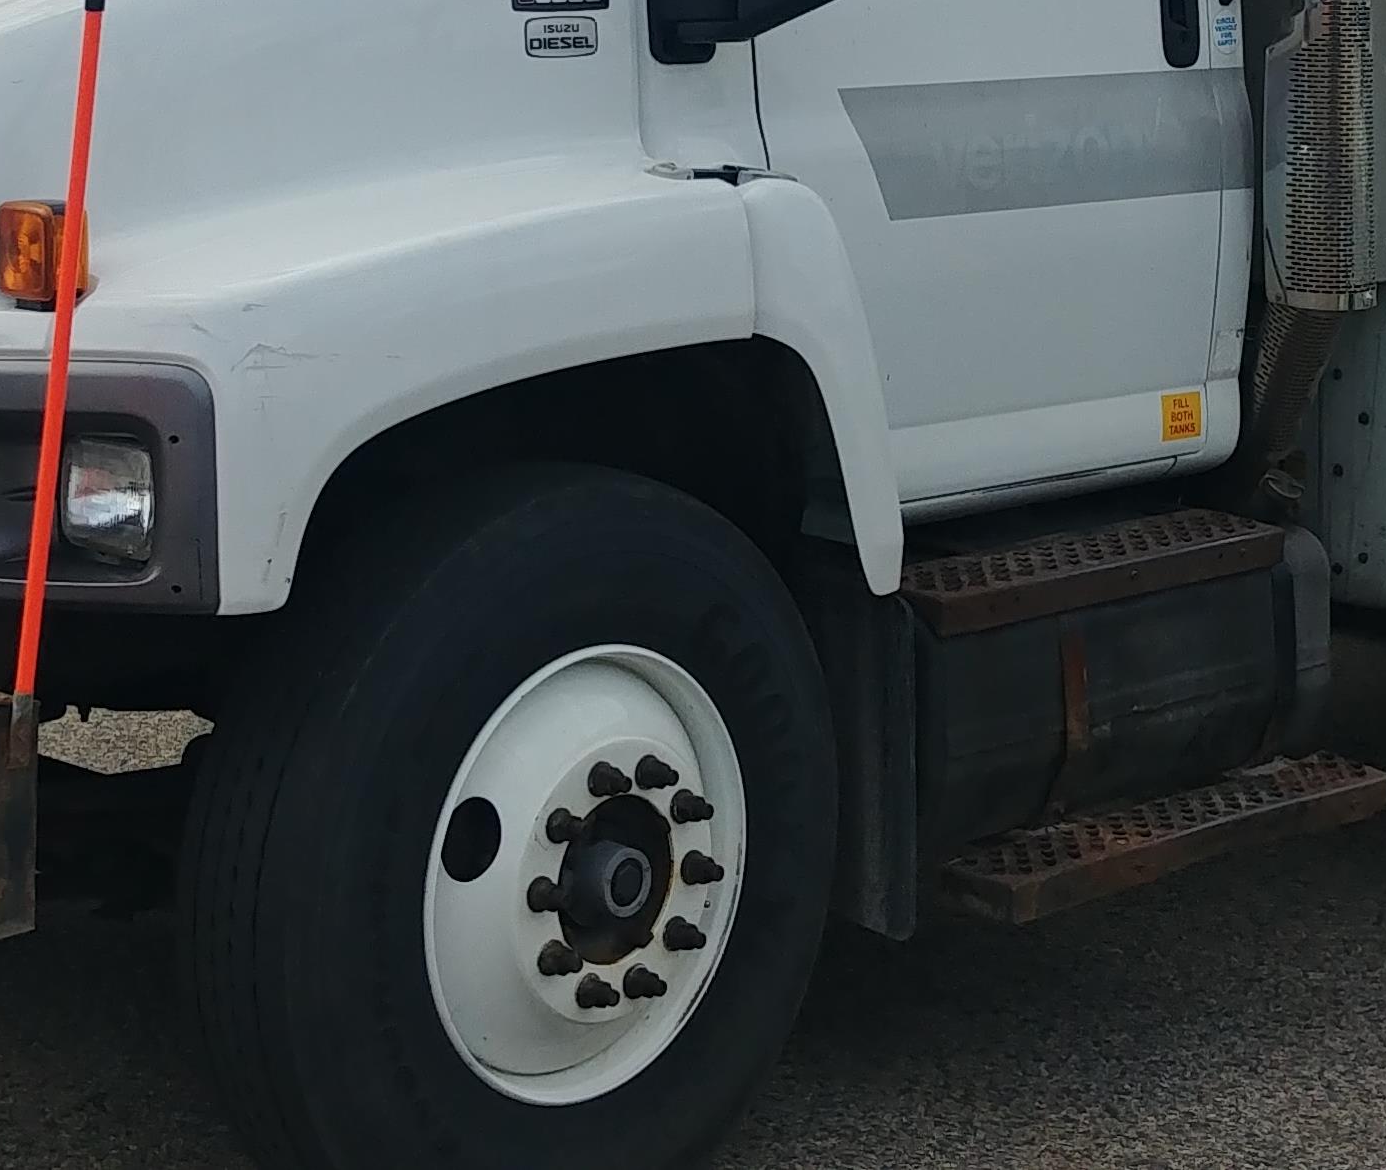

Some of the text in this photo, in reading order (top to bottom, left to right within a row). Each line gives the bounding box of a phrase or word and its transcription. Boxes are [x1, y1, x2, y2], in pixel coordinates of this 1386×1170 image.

[542, 23, 580, 34] ISUZU
[529, 36, 595, 50] DIESEL
[1172, 397, 1190, 410] FILL
[1170, 410, 1194, 423] BOTH
[1168, 422, 1196, 436] TANKS
